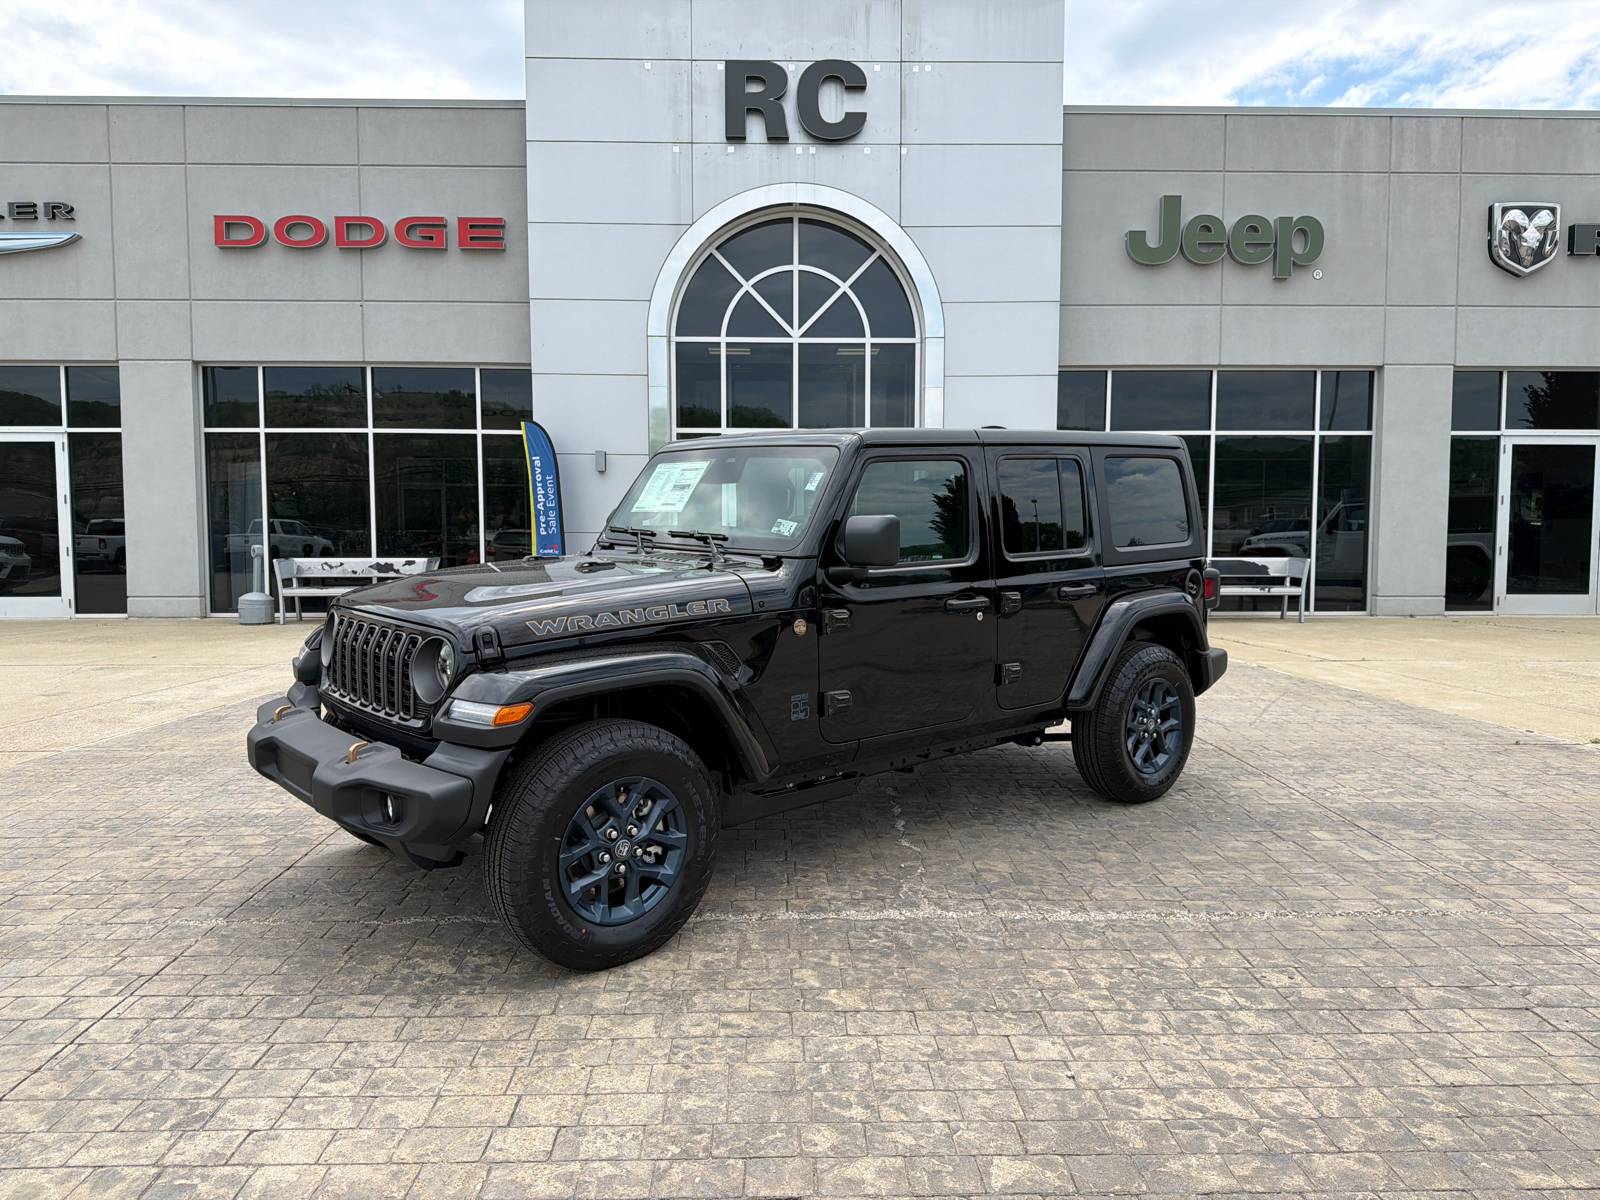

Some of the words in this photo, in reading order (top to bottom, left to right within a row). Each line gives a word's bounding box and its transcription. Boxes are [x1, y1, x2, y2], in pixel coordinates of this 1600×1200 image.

[725, 59, 867, 142] RC
[0, 202, 76, 220] ER
[213, 215, 505, 251] DODGE
[1125, 195, 1325, 280] Jeep
[532, 456, 547, 535] Pre-Approval
[546, 475, 555, 507] Event
[547, 510, 557, 534] Sale
[526, 598, 731, 636] WRANGLER
[684, 780, 707, 856] NEXEN
[542, 878, 582, 940] ROADIAN
